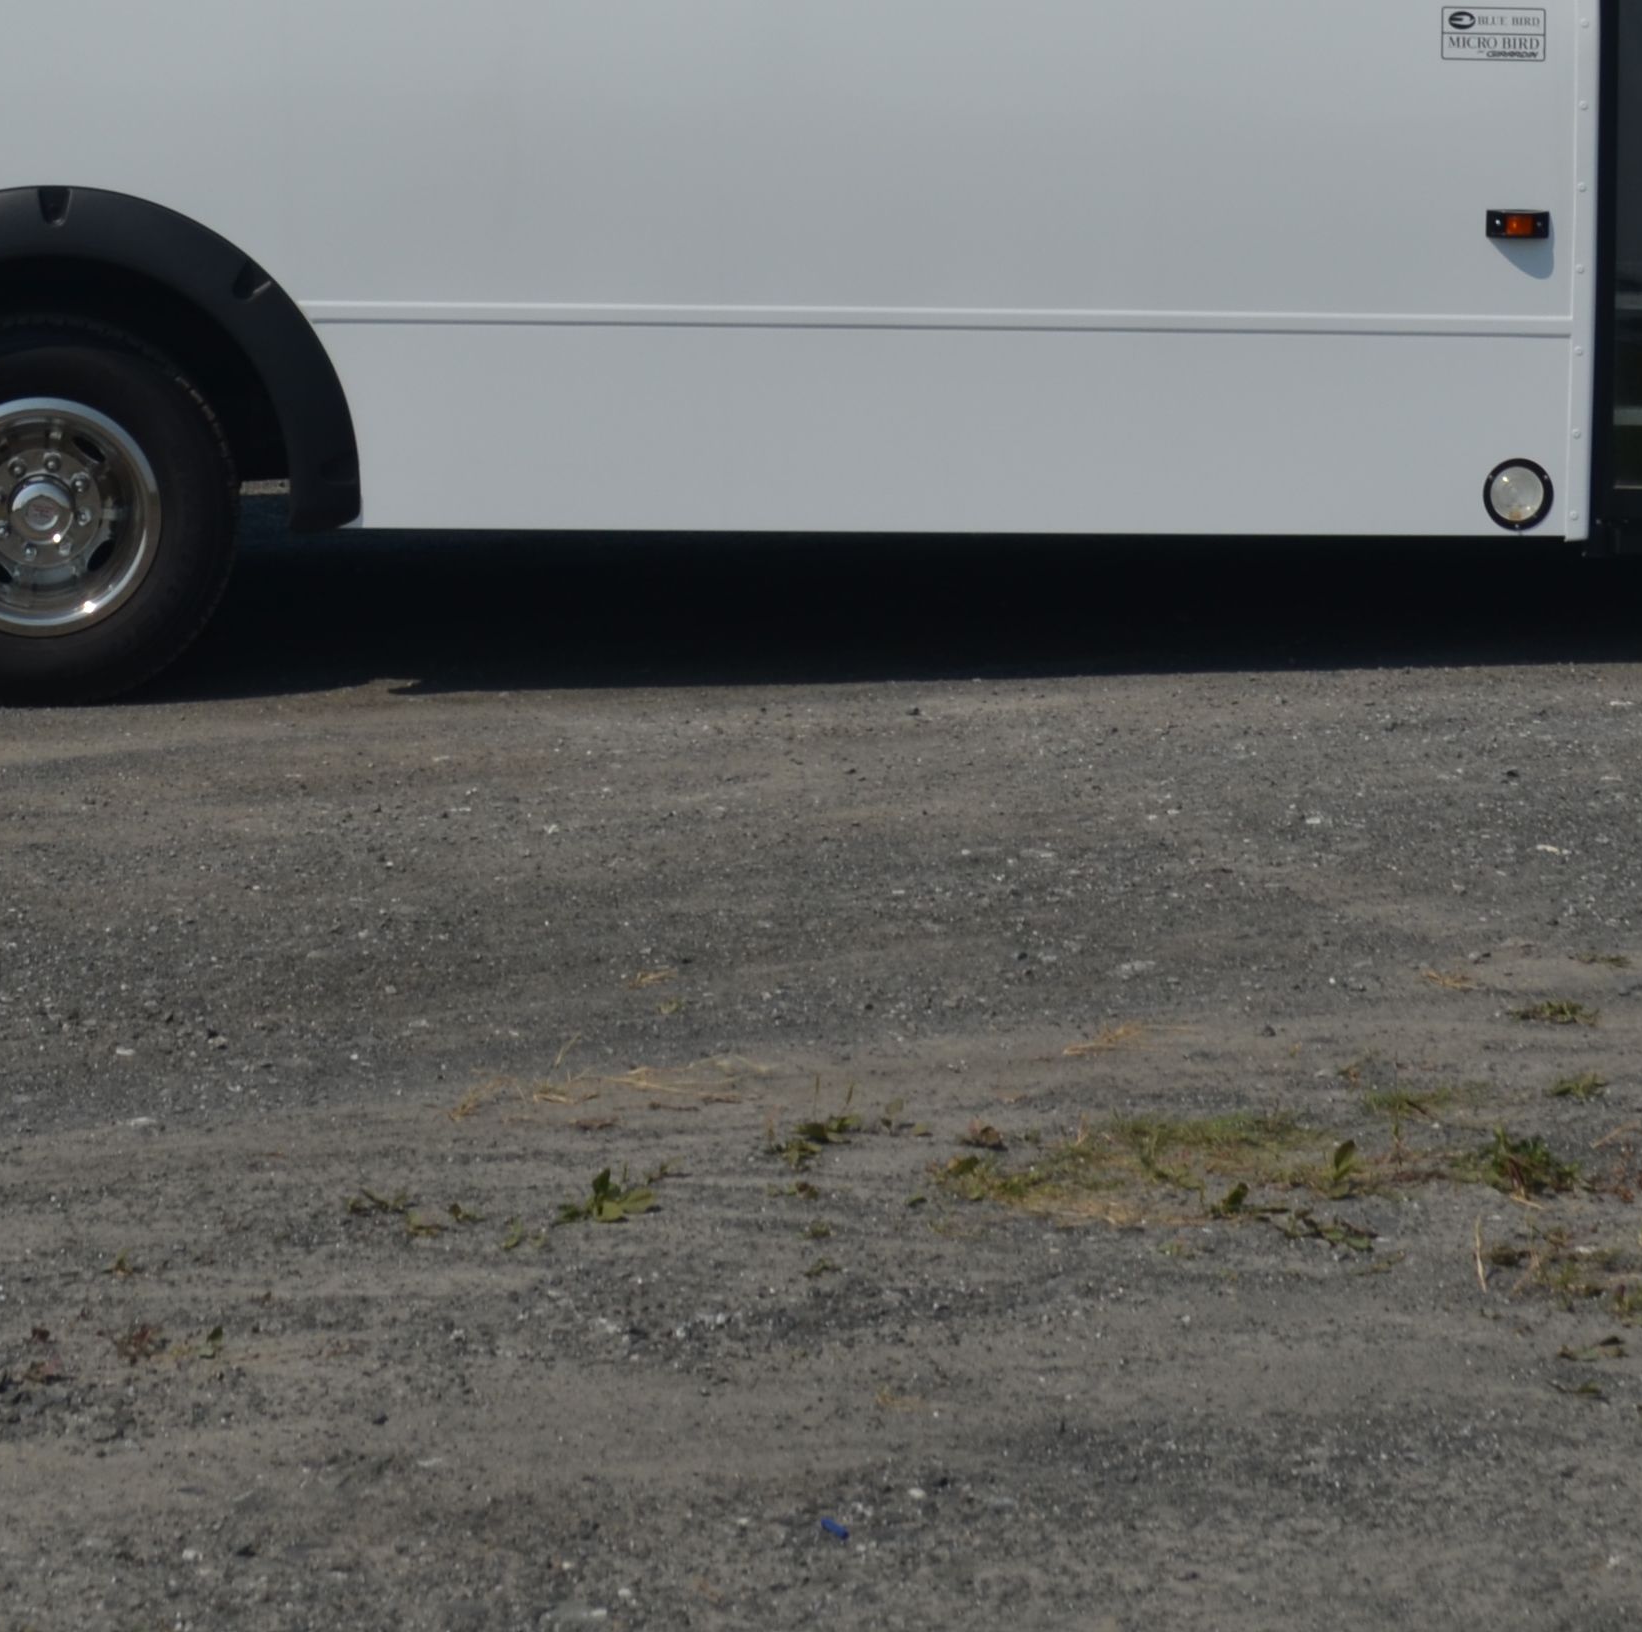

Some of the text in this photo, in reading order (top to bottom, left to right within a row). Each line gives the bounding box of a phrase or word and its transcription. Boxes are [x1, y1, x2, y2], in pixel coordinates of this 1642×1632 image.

[1477, 16, 1541, 27] BLUE BIRD
[1448, 36, 1540, 50] MICRO BIRD
[1486, 50, 1539, 58] GIRARDIN
